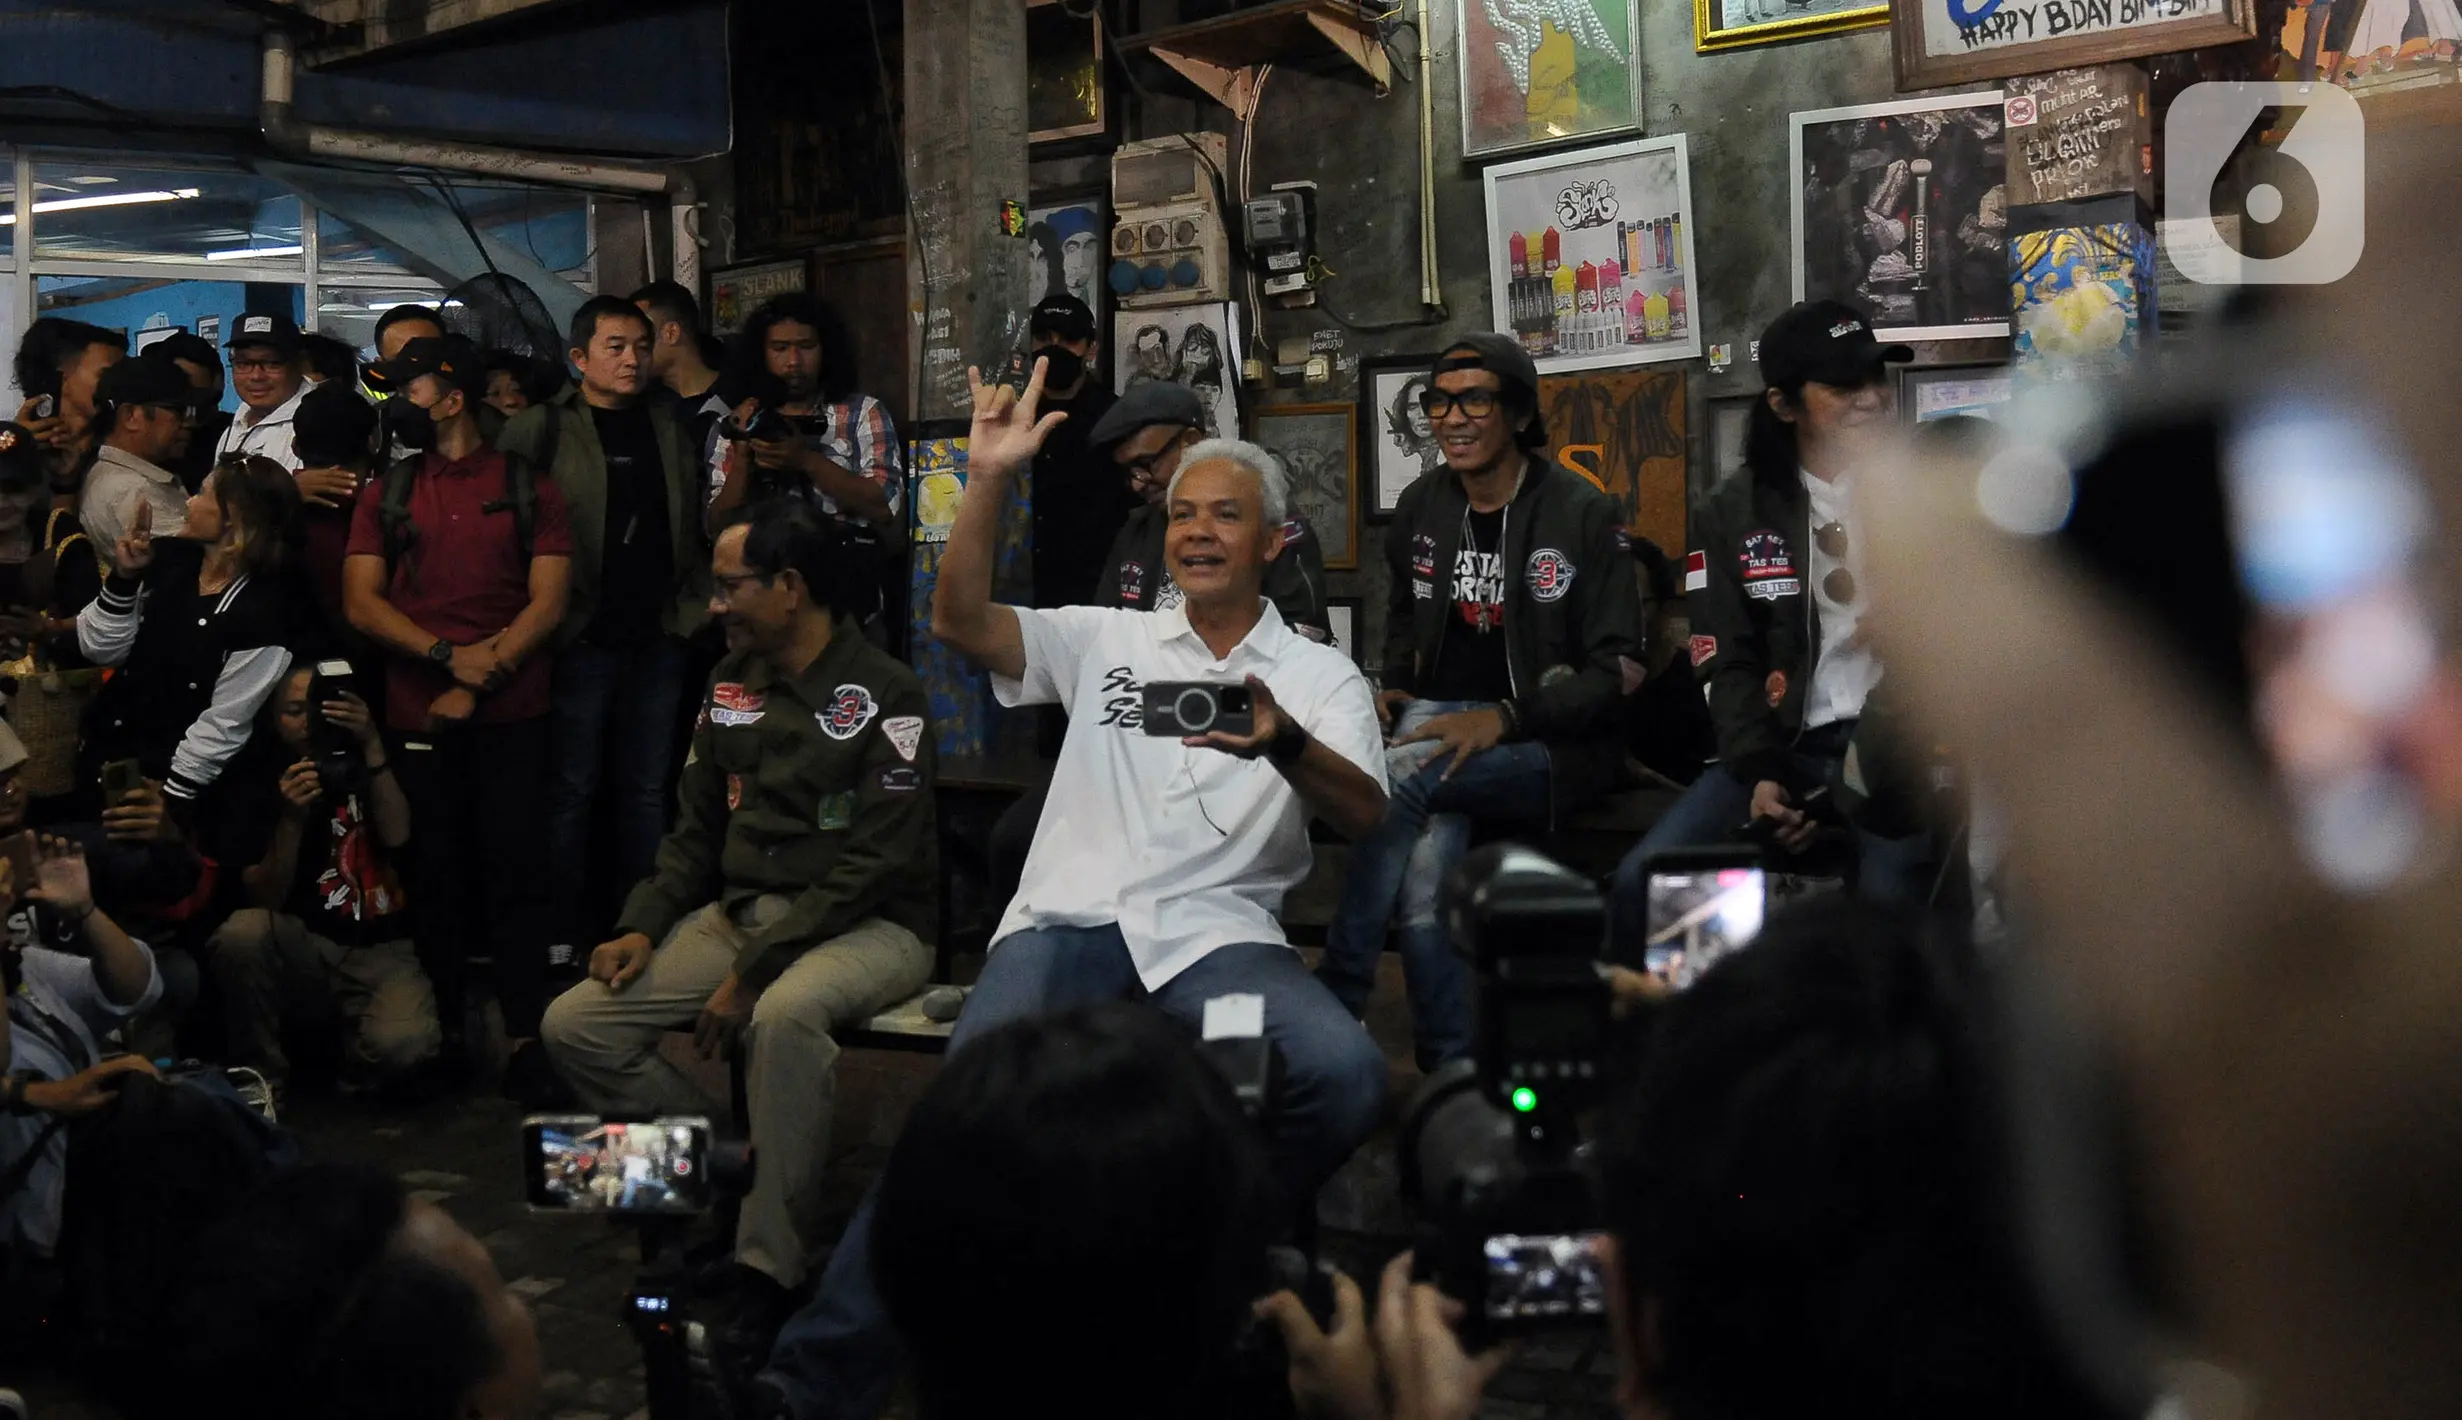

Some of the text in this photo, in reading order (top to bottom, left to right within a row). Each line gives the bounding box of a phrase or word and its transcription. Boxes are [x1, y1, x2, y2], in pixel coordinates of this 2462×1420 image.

[1959, 3, 2036, 49] HAPPY
[1536, 560, 1558, 588] 3
[1748, 558, 1767, 568] TAS
[1771, 557, 1788, 566] TES
[832, 695, 861, 728] 3
